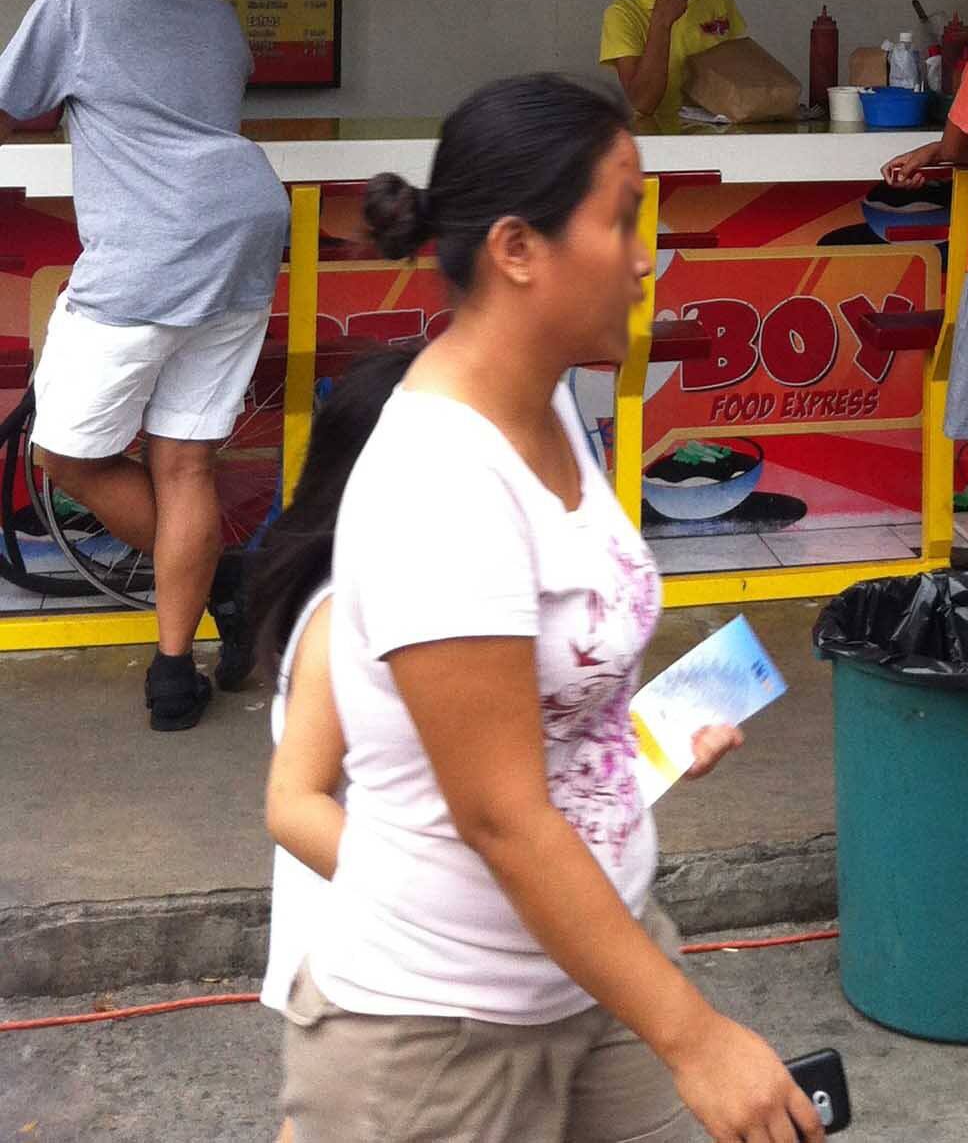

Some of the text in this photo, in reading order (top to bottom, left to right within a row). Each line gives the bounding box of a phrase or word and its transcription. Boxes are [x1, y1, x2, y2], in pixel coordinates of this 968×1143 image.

[680, 293, 914, 392] BOY
[709, 389, 881, 423] FOOD EXPRESS
